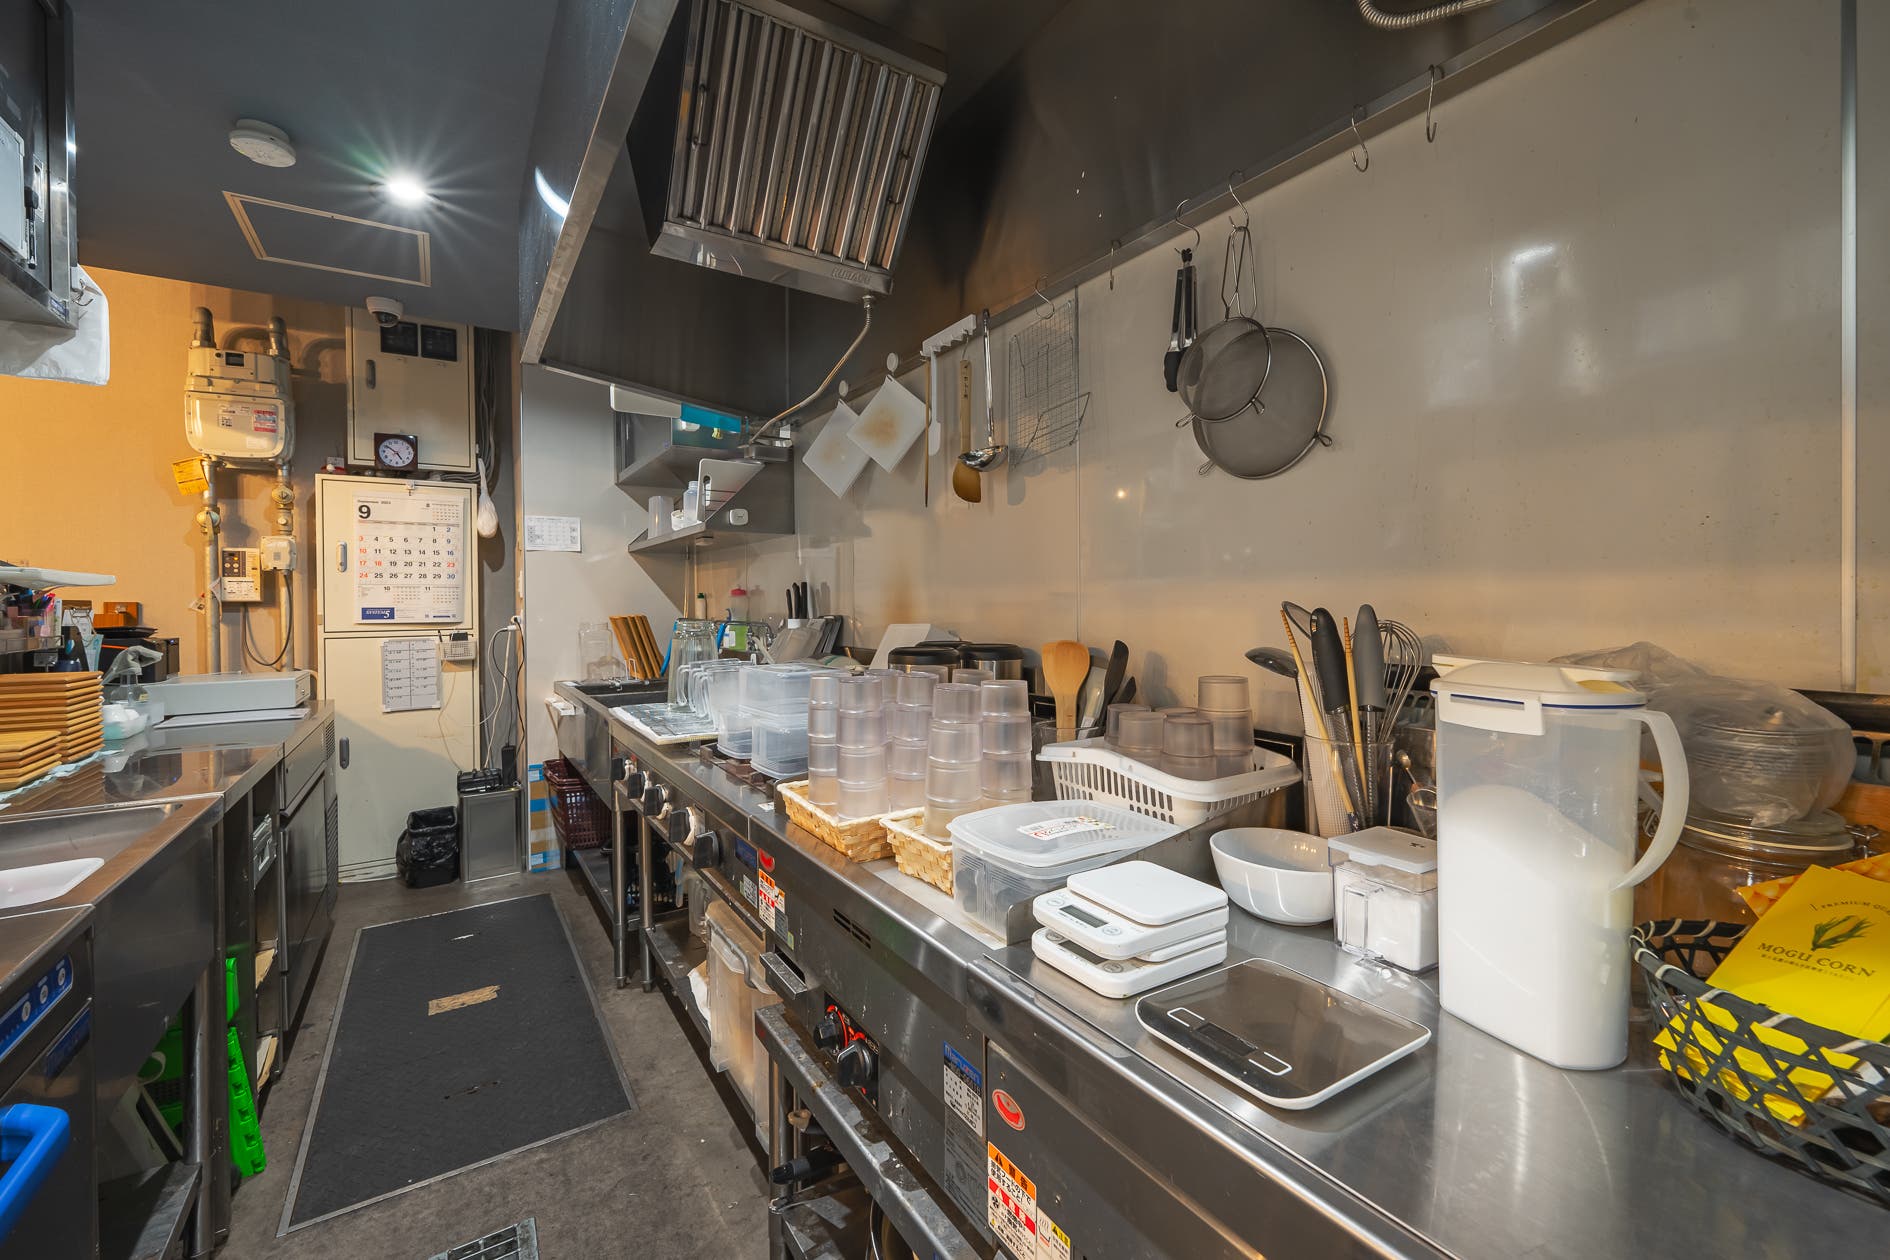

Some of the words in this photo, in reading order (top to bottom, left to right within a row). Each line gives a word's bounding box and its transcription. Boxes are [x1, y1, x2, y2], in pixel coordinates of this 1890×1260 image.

[358, 504, 371, 519] 9
[1758, 942, 1812, 962] MOGU
[1816, 957, 1876, 977] CORN
